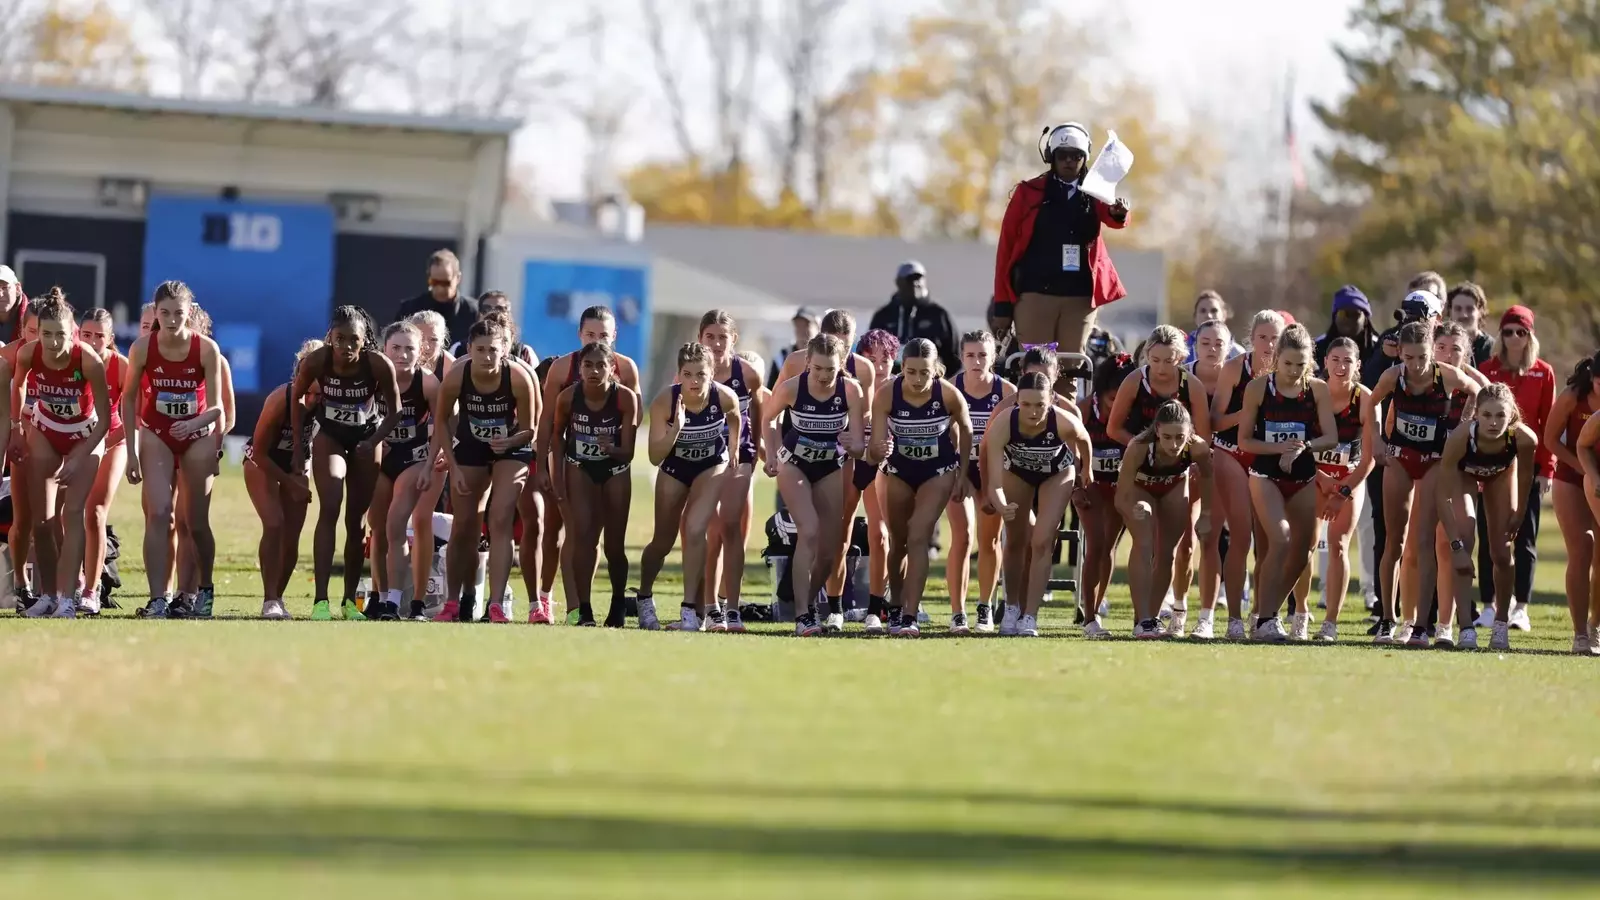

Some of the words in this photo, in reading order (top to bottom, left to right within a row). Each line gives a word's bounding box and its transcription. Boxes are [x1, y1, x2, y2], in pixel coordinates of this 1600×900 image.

[152, 379, 198, 388] INDIANA
[323, 386, 343, 397] OHIO
[345, 387, 369, 398] STATE
[48, 404, 73, 416] 124
[165, 403, 189, 415] 118
[467, 403, 485, 413] OHIO
[487, 402, 509, 413] STATE
[334, 410, 359, 423] 221
[474, 426, 502, 438] 226
[573, 422, 592, 434] OHIO
[1403, 422, 1428, 438] 138
[582, 442, 608, 456] 22
[681, 448, 710, 459] 205
[802, 448, 828, 460] 214
[904, 446, 933, 457] 204
